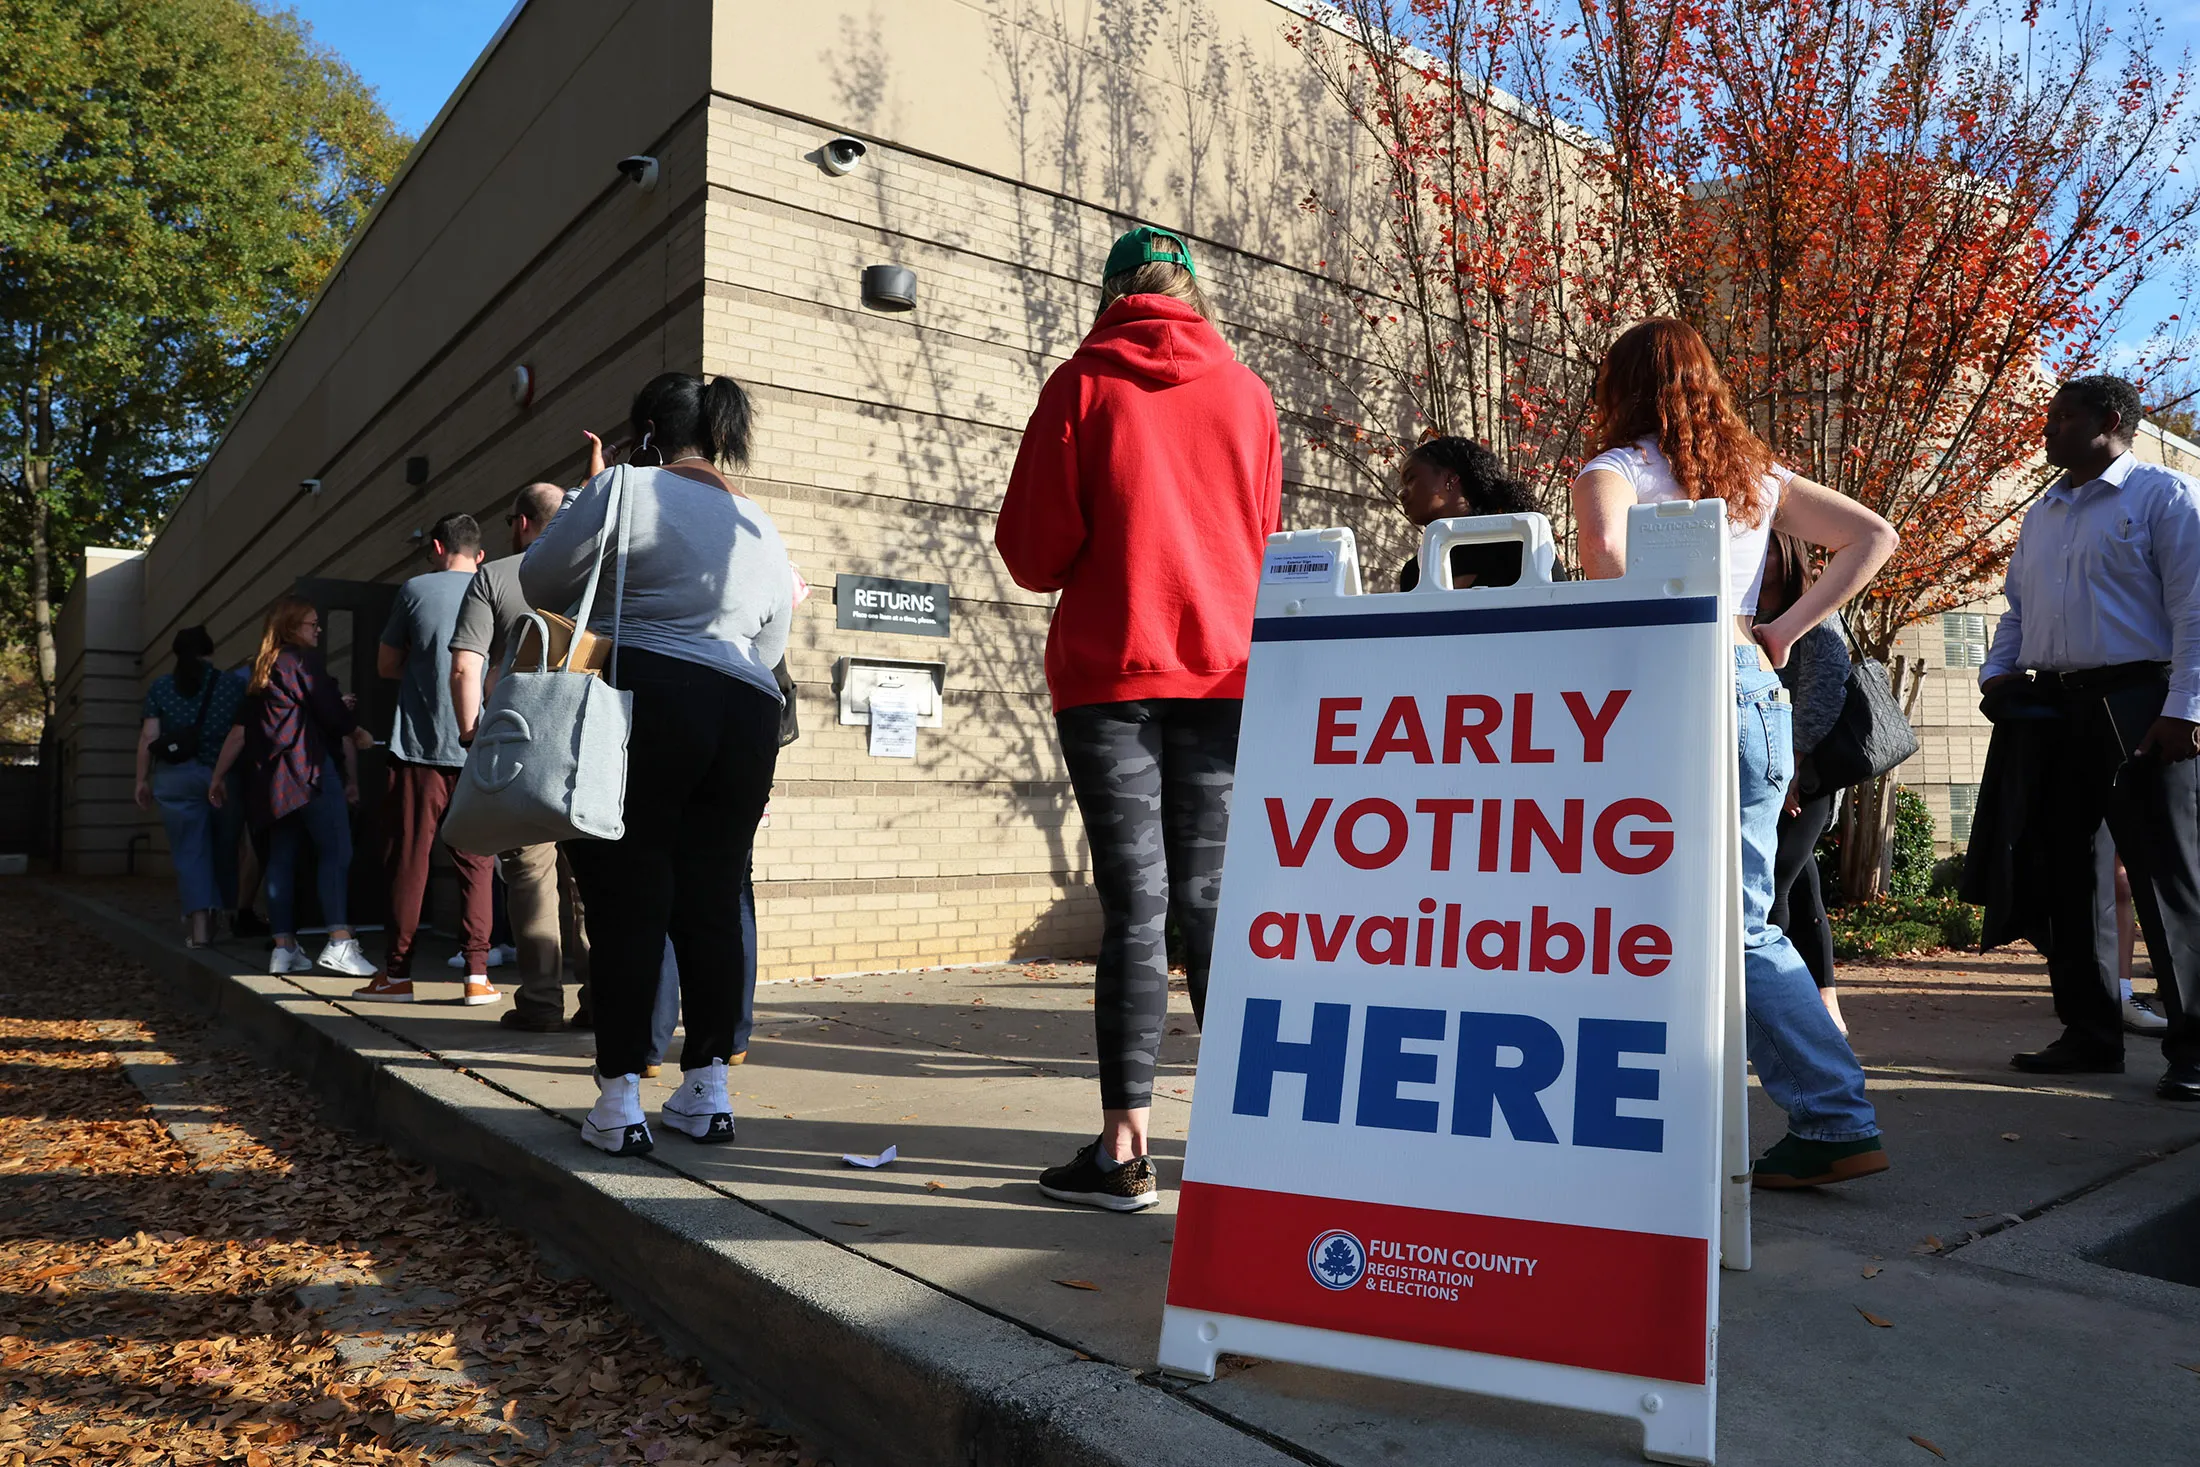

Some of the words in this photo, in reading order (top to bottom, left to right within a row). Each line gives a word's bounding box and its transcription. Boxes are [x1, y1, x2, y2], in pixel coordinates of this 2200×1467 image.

[855, 588, 935, 613] RETURNS
[1313, 689, 1632, 765] EARLY
[1264, 797, 1674, 875] VOTING
[1248, 897, 1673, 977] available
[1232, 997, 1667, 1153] HERE
[1367, 1262, 1474, 1288] REGISTRATION
[1369, 1239, 1448, 1266] FULTON
[1451, 1250, 1538, 1277] COUNTY
[1365, 1277, 1377, 1291] &
[1379, 1279, 1459, 1302] ELECTIONS
